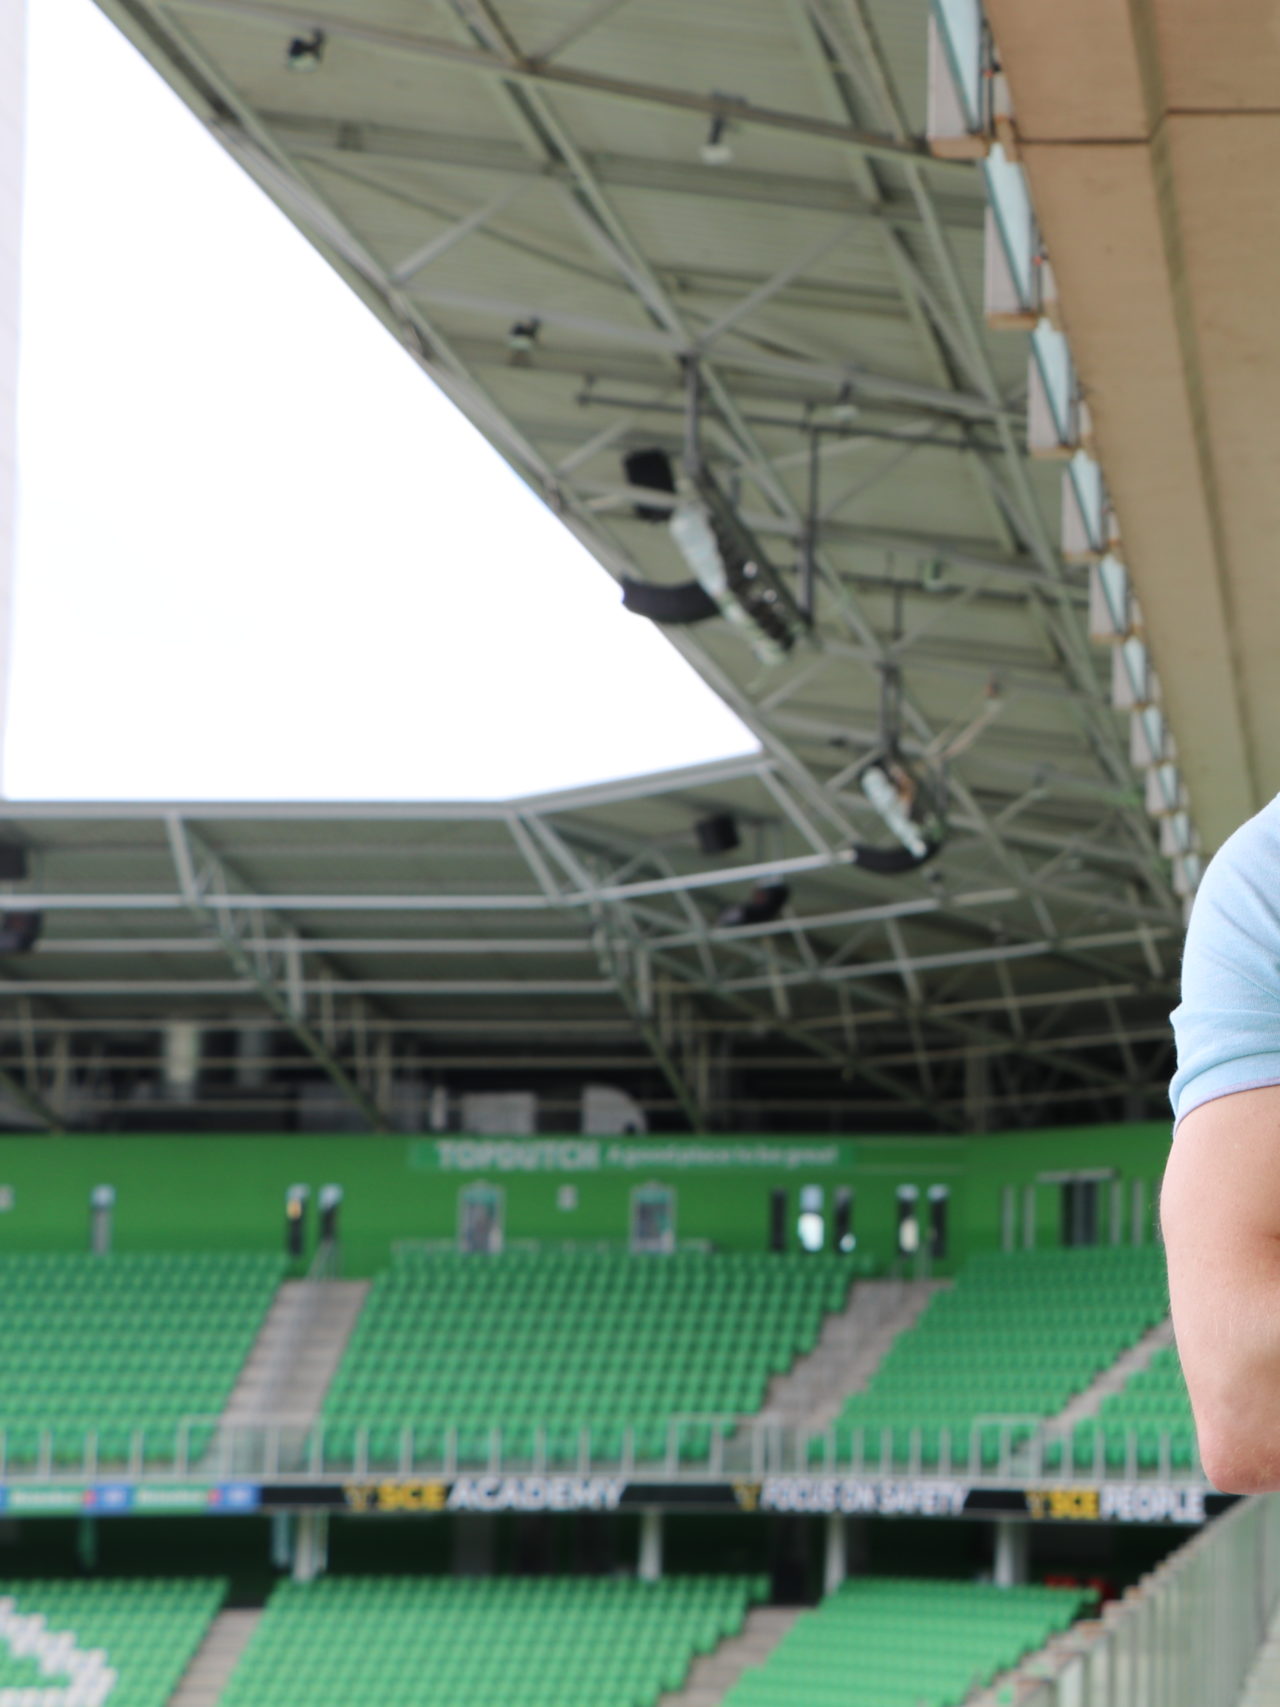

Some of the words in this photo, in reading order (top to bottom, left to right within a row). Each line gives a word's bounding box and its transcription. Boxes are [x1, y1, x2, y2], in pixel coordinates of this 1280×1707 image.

[448, 1477, 625, 1509] ACADEMY
[762, 1479, 837, 1511] FOCUS
[841, 1481, 875, 1512] ON
[879, 1481, 966, 1514] SAFETY
[1101, 1486, 1205, 1522] PEOPLE
